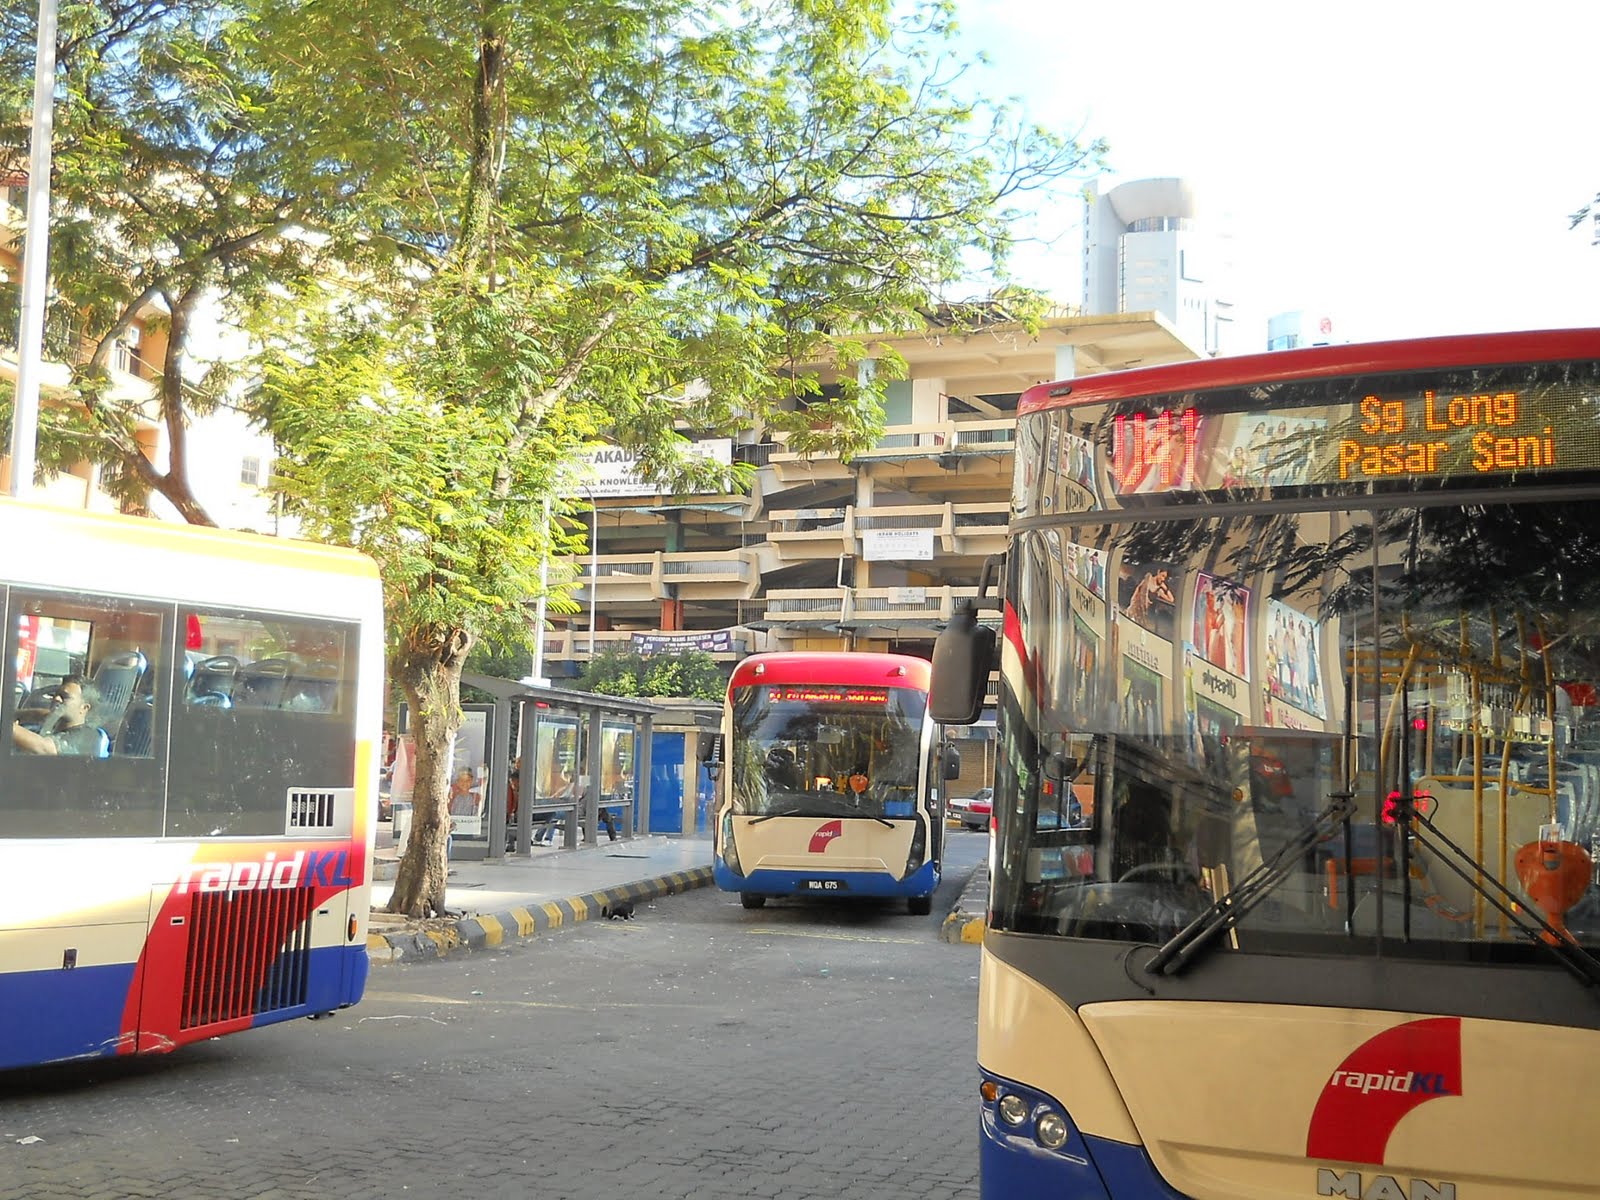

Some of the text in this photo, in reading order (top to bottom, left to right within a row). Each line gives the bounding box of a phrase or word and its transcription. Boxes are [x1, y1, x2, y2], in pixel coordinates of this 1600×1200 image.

[1359, 389, 1517, 435] Sg Long
[594, 449, 642, 464] AKADE
[1114, 408, 1195, 486] U41
[1338, 426, 1555, 480] Pasar Seni
[177, 850, 353, 901] rapidKL
[824, 881, 838, 889] 675
[1331, 1070, 1450, 1094] rapidKL
[1317, 1168, 1456, 1200] MAN
